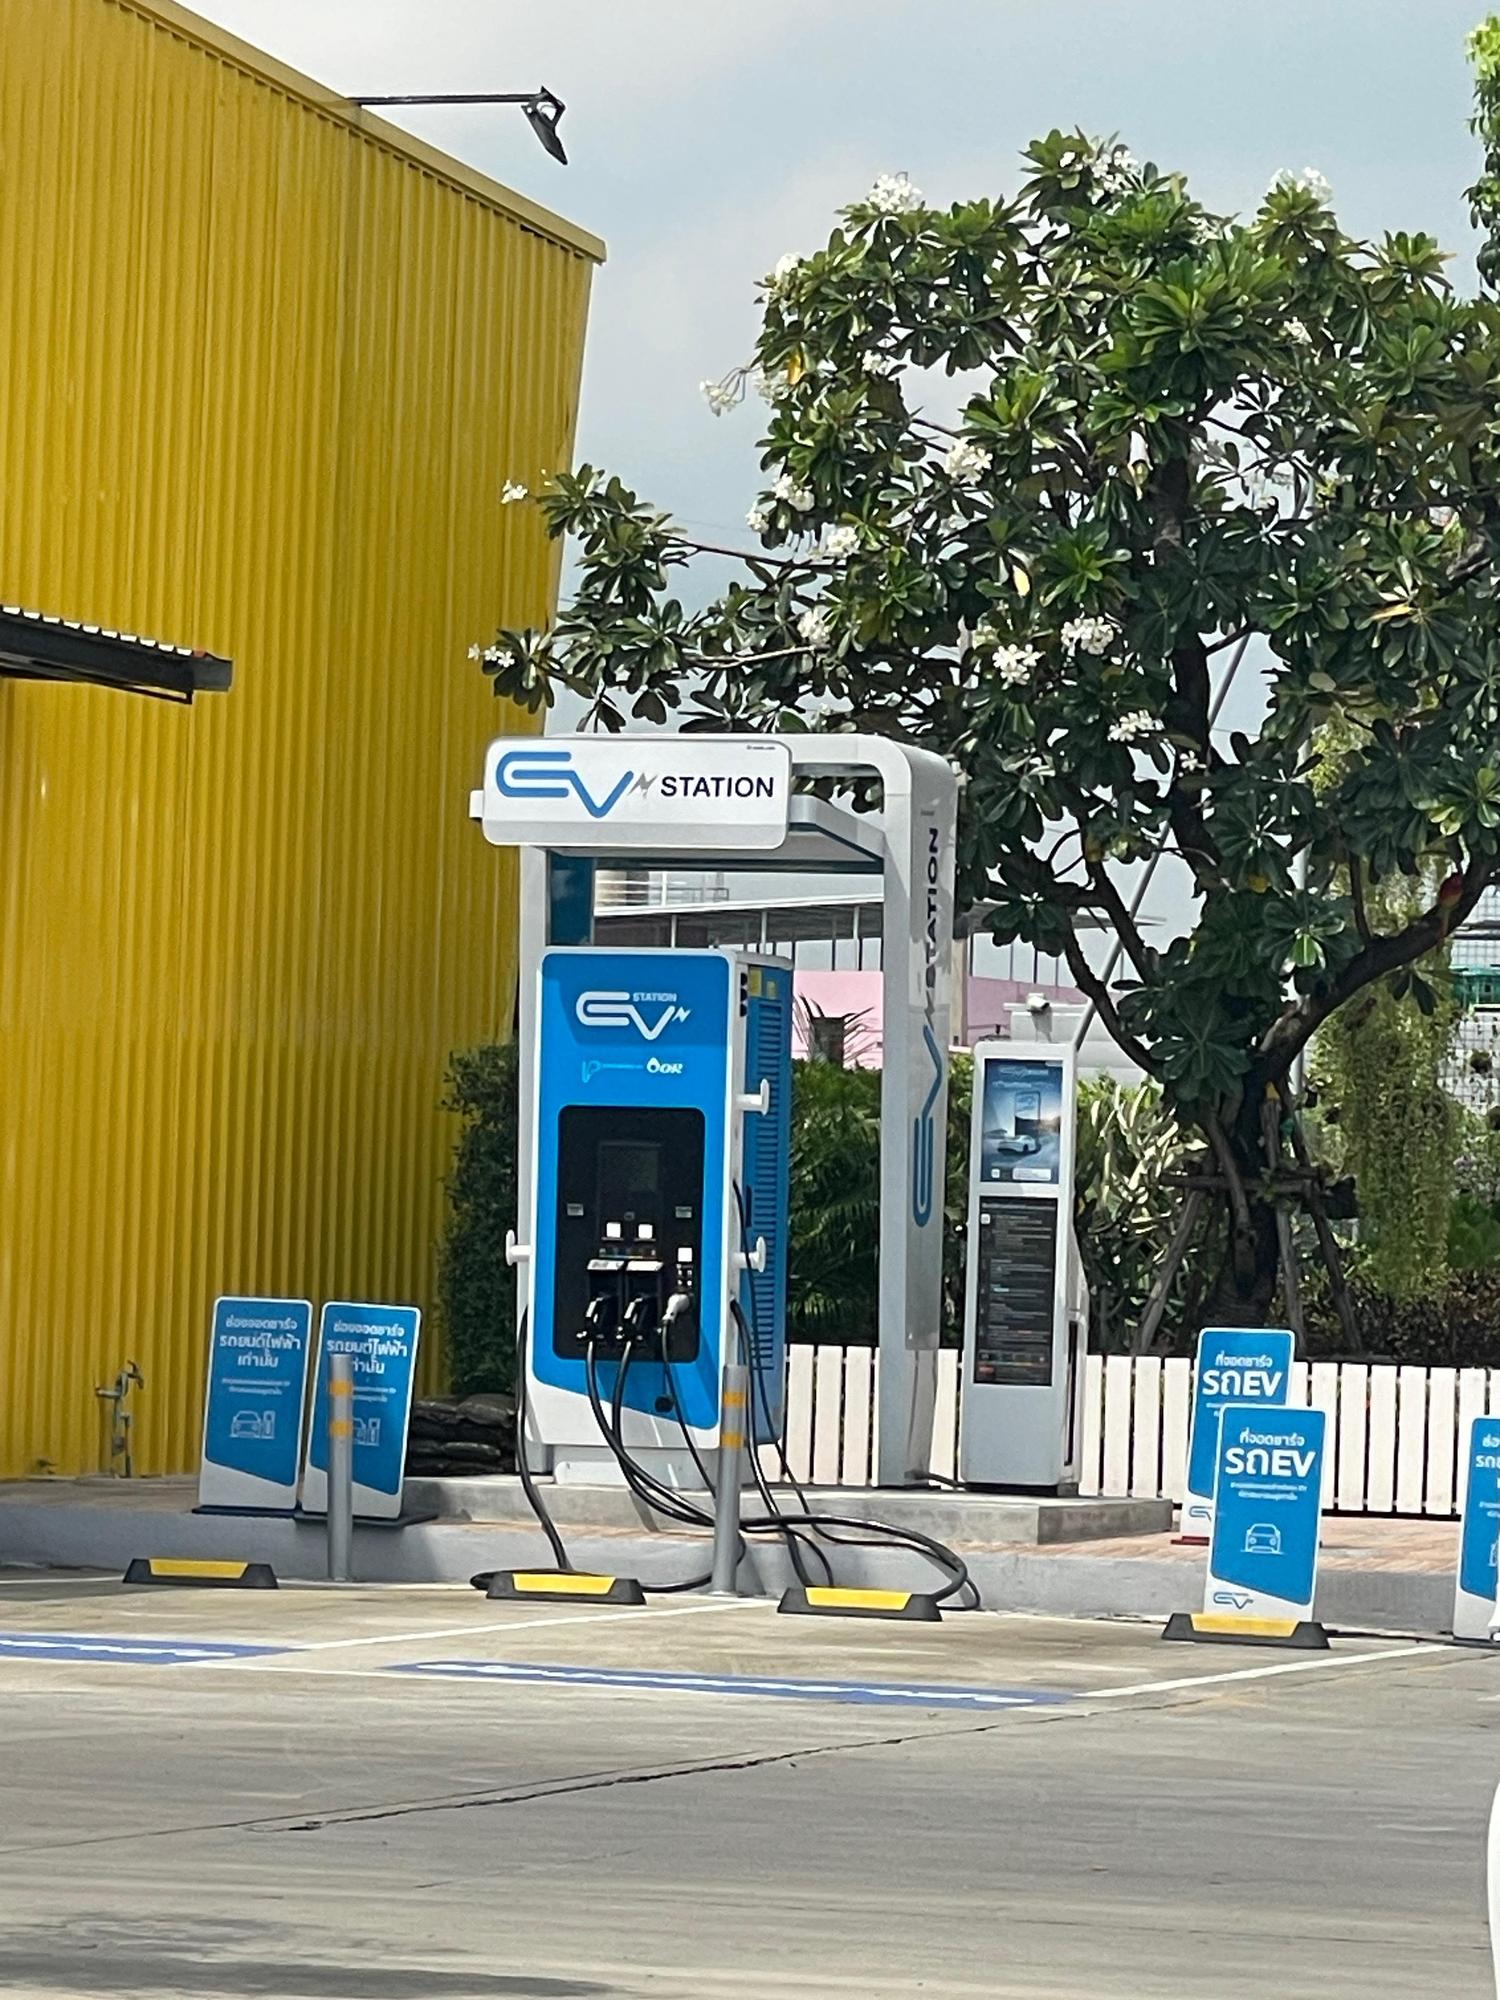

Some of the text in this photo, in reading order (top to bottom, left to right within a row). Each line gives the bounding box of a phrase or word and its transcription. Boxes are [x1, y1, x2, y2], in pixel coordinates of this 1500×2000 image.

[496, 752, 774, 819] EV STATION
[926, 828, 938, 988] STATION
[632, 992, 678, 1002] STATION
[576, 991, 676, 1040] EV
[219, 1332, 301, 1350] รถยนต์ไฟฟ้า
[326, 1338, 408, 1358] รถยนต์ไฟฟ้า
[1239, 1427, 1305, 1446] ที่จอดชาร์จ
